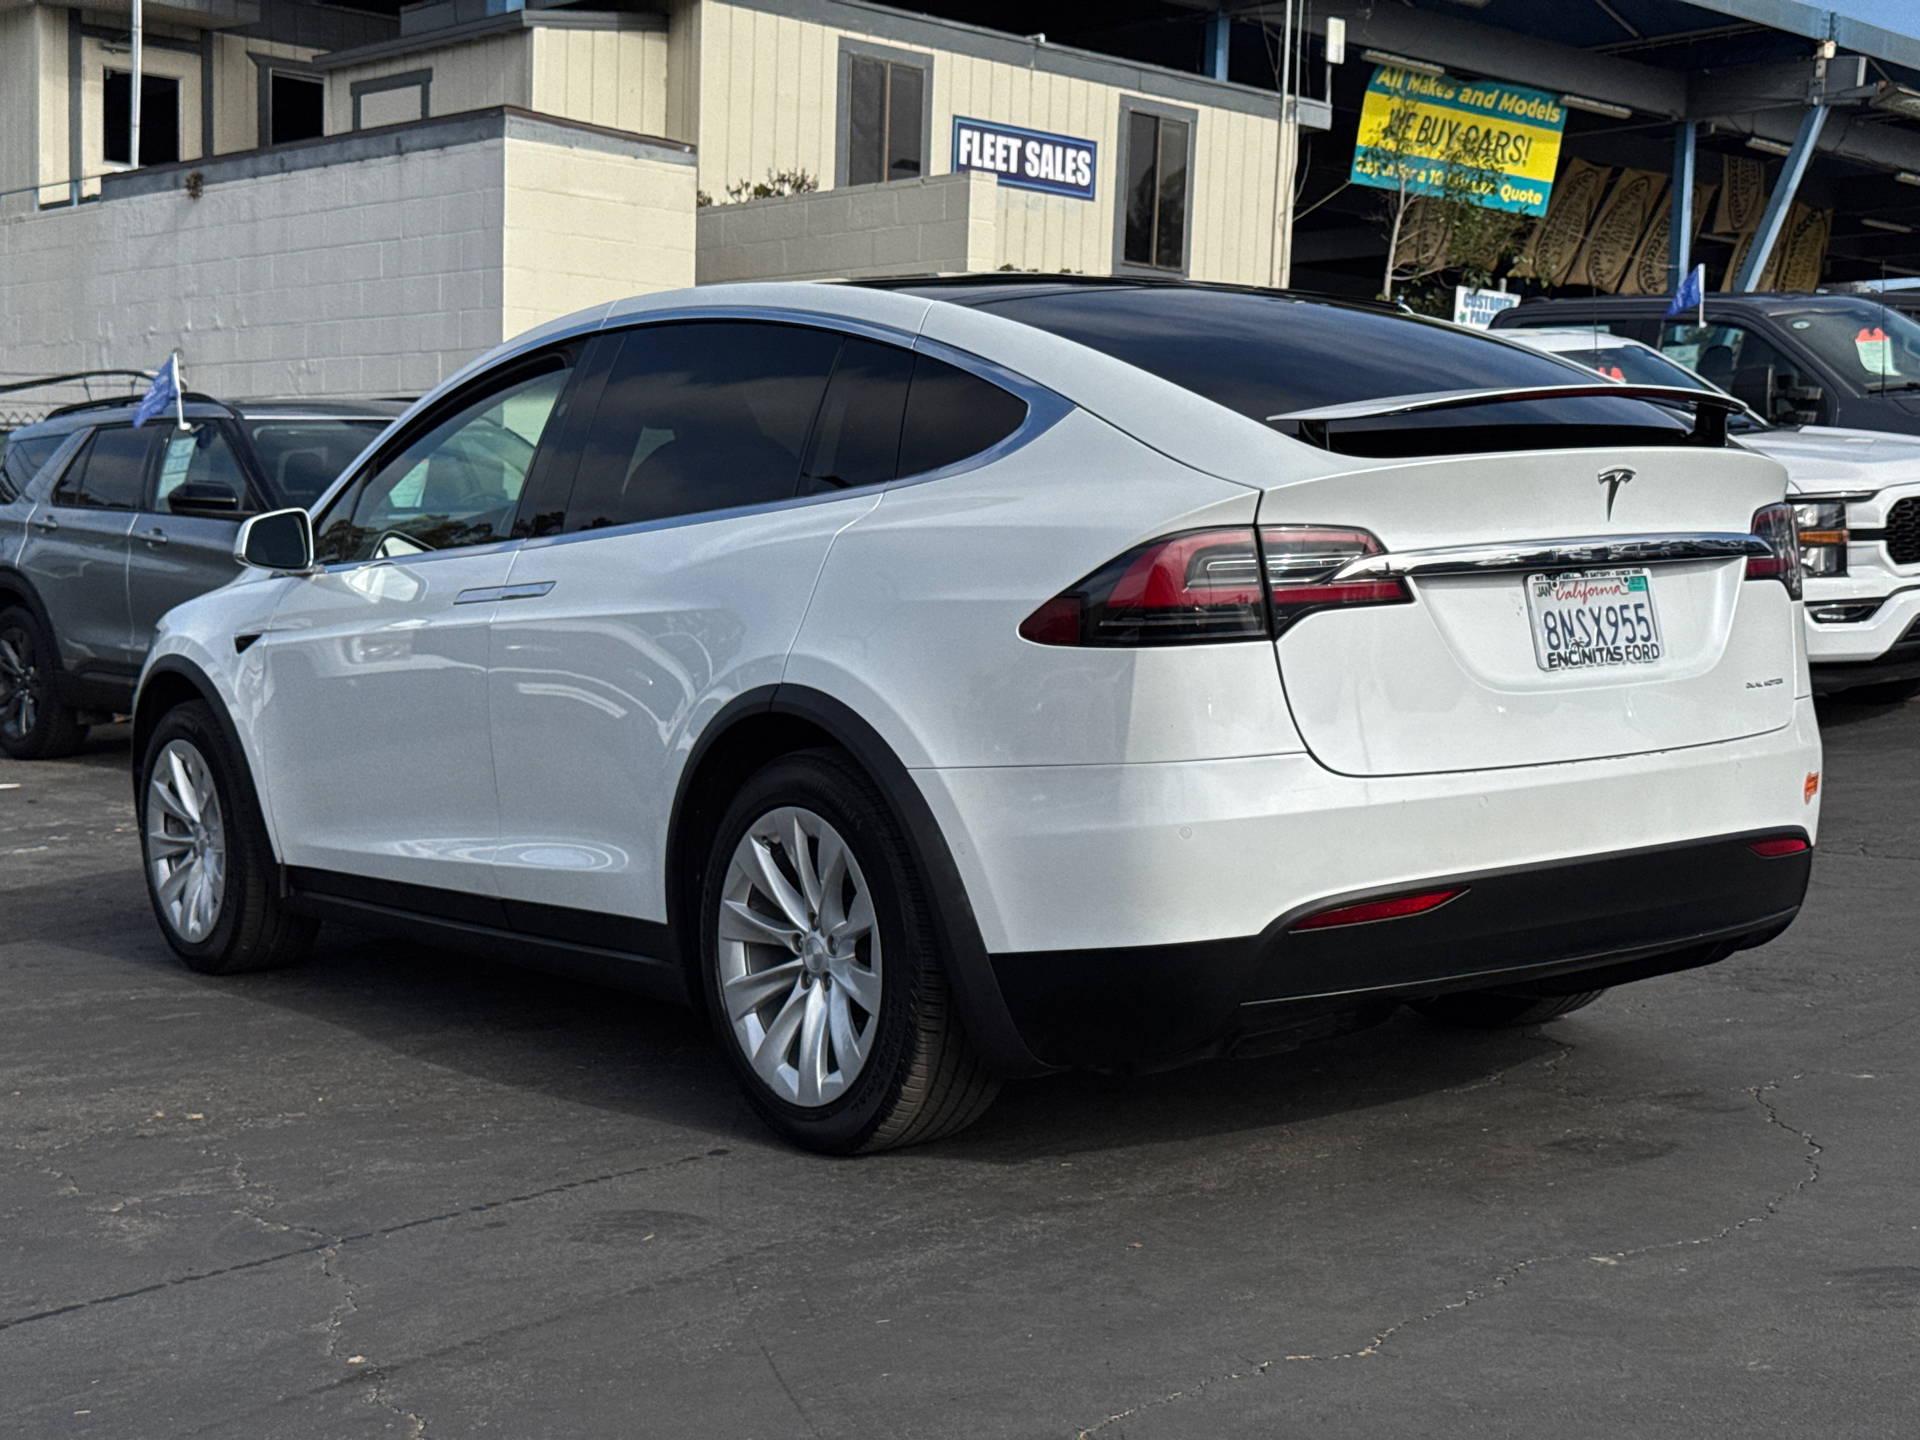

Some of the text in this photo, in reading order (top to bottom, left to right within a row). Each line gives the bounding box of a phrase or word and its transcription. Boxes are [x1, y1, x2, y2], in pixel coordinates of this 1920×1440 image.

[1375, 66, 1561, 123] All Makes and Models
[959, 128, 1092, 187] FLEET SALES
[1416, 114, 1462, 149] BUY
[1461, 125, 1533, 168] CARS!
[1416, 170, 1427, 183] a
[1428, 169, 1445, 186] 10
[1500, 184, 1543, 205] Quote
[1537, 585, 1552, 598] JAN
[1555, 579, 1630, 605] California
[1543, 603, 1653, 650] 8NSX955
[1547, 643, 1661, 669] ENCINITAS FORD
